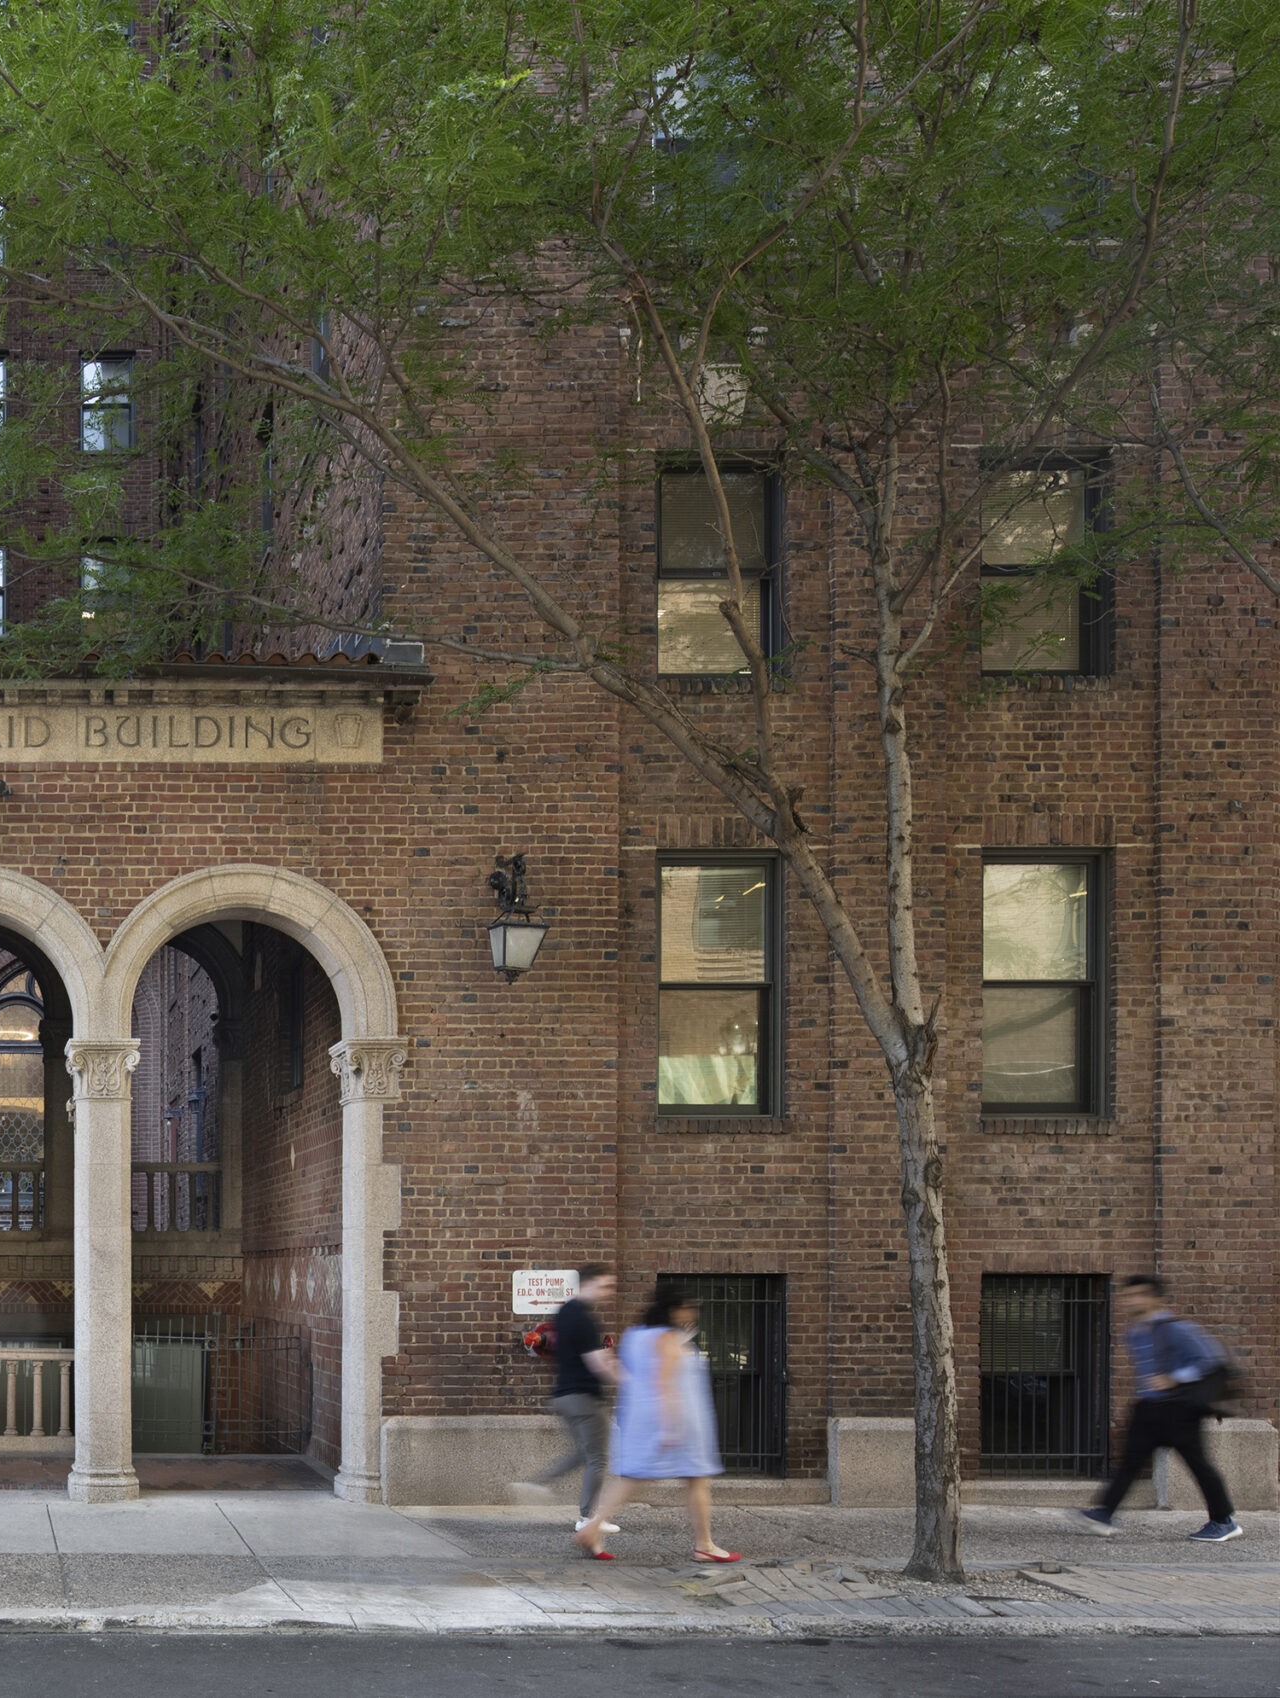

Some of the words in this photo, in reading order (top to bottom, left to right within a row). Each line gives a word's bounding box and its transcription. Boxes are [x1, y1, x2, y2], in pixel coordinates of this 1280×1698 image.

[85, 716, 312, 748] BUILDING
[528, 1278, 543, 1287] TEST
[545, 1278, 565, 1287] PUMP
[536, 1288, 545, 1297] ON
